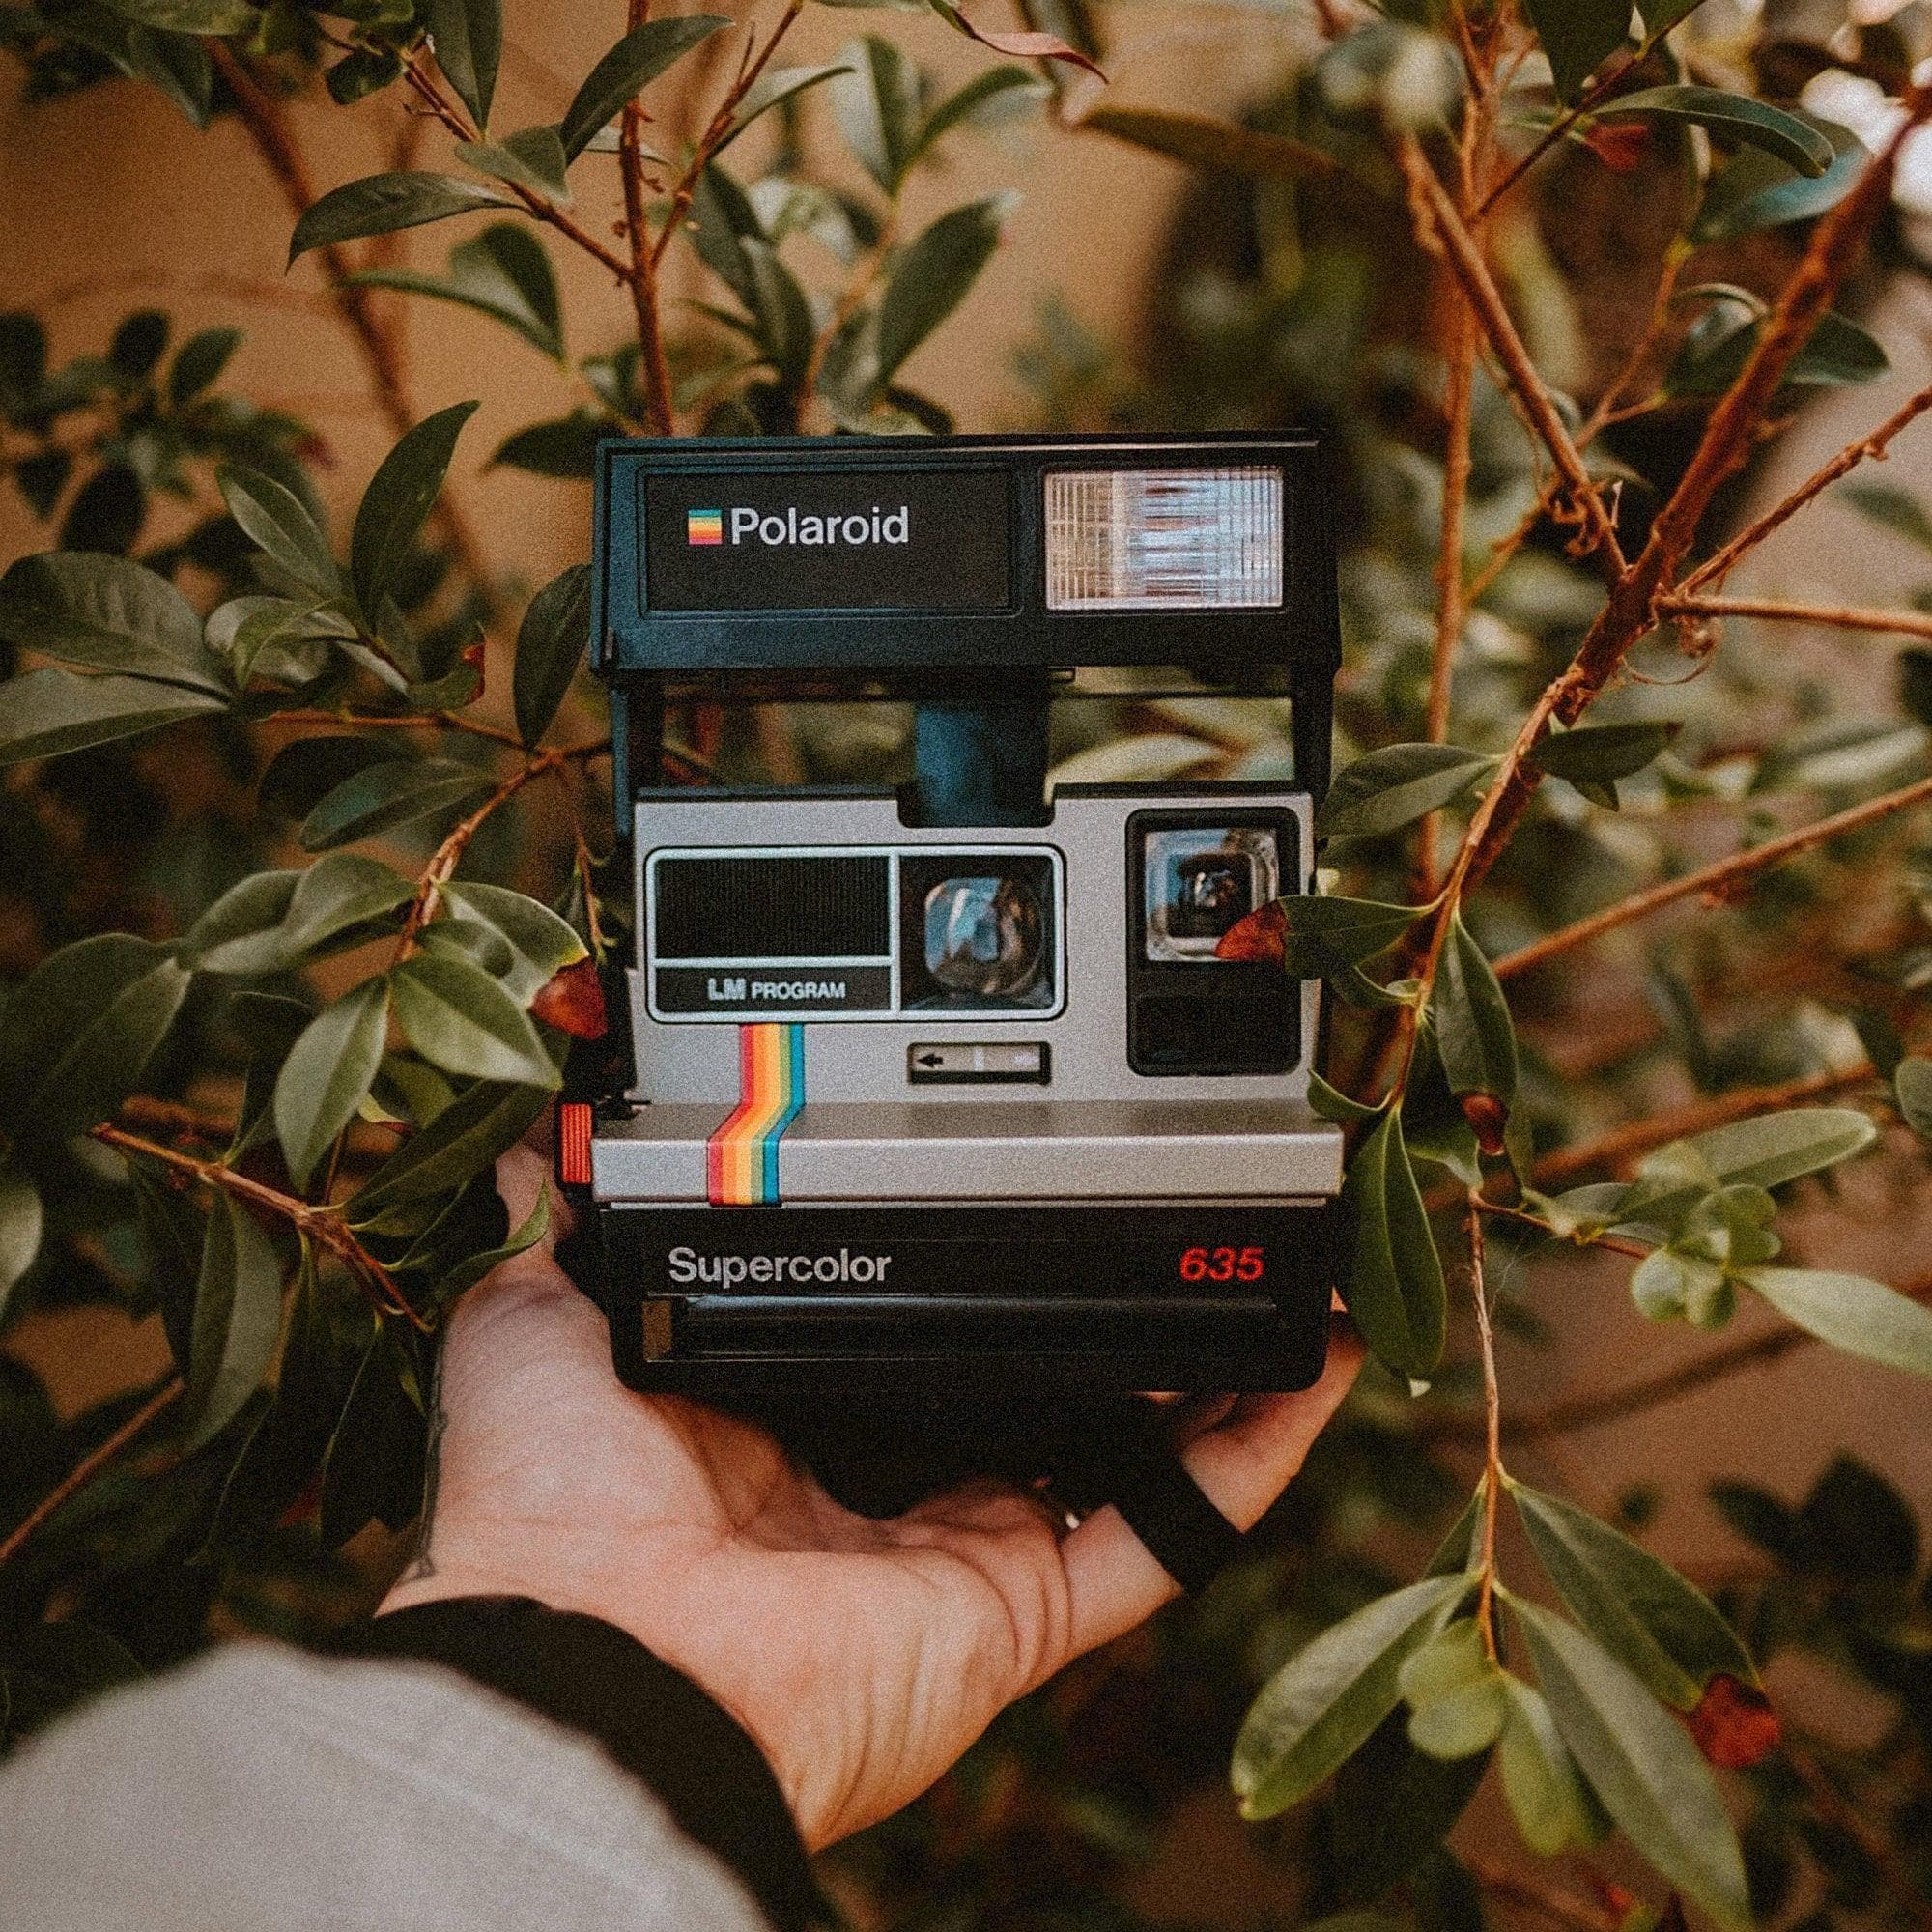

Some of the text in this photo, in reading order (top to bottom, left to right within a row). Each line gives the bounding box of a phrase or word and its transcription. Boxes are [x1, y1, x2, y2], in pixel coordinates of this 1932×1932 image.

[730, 506, 909, 545] Polaroid
[708, 978, 846, 1000] LM PROGRAM
[668, 1246, 892, 1289] Supercolor
[1179, 1247, 1264, 1282] 635
